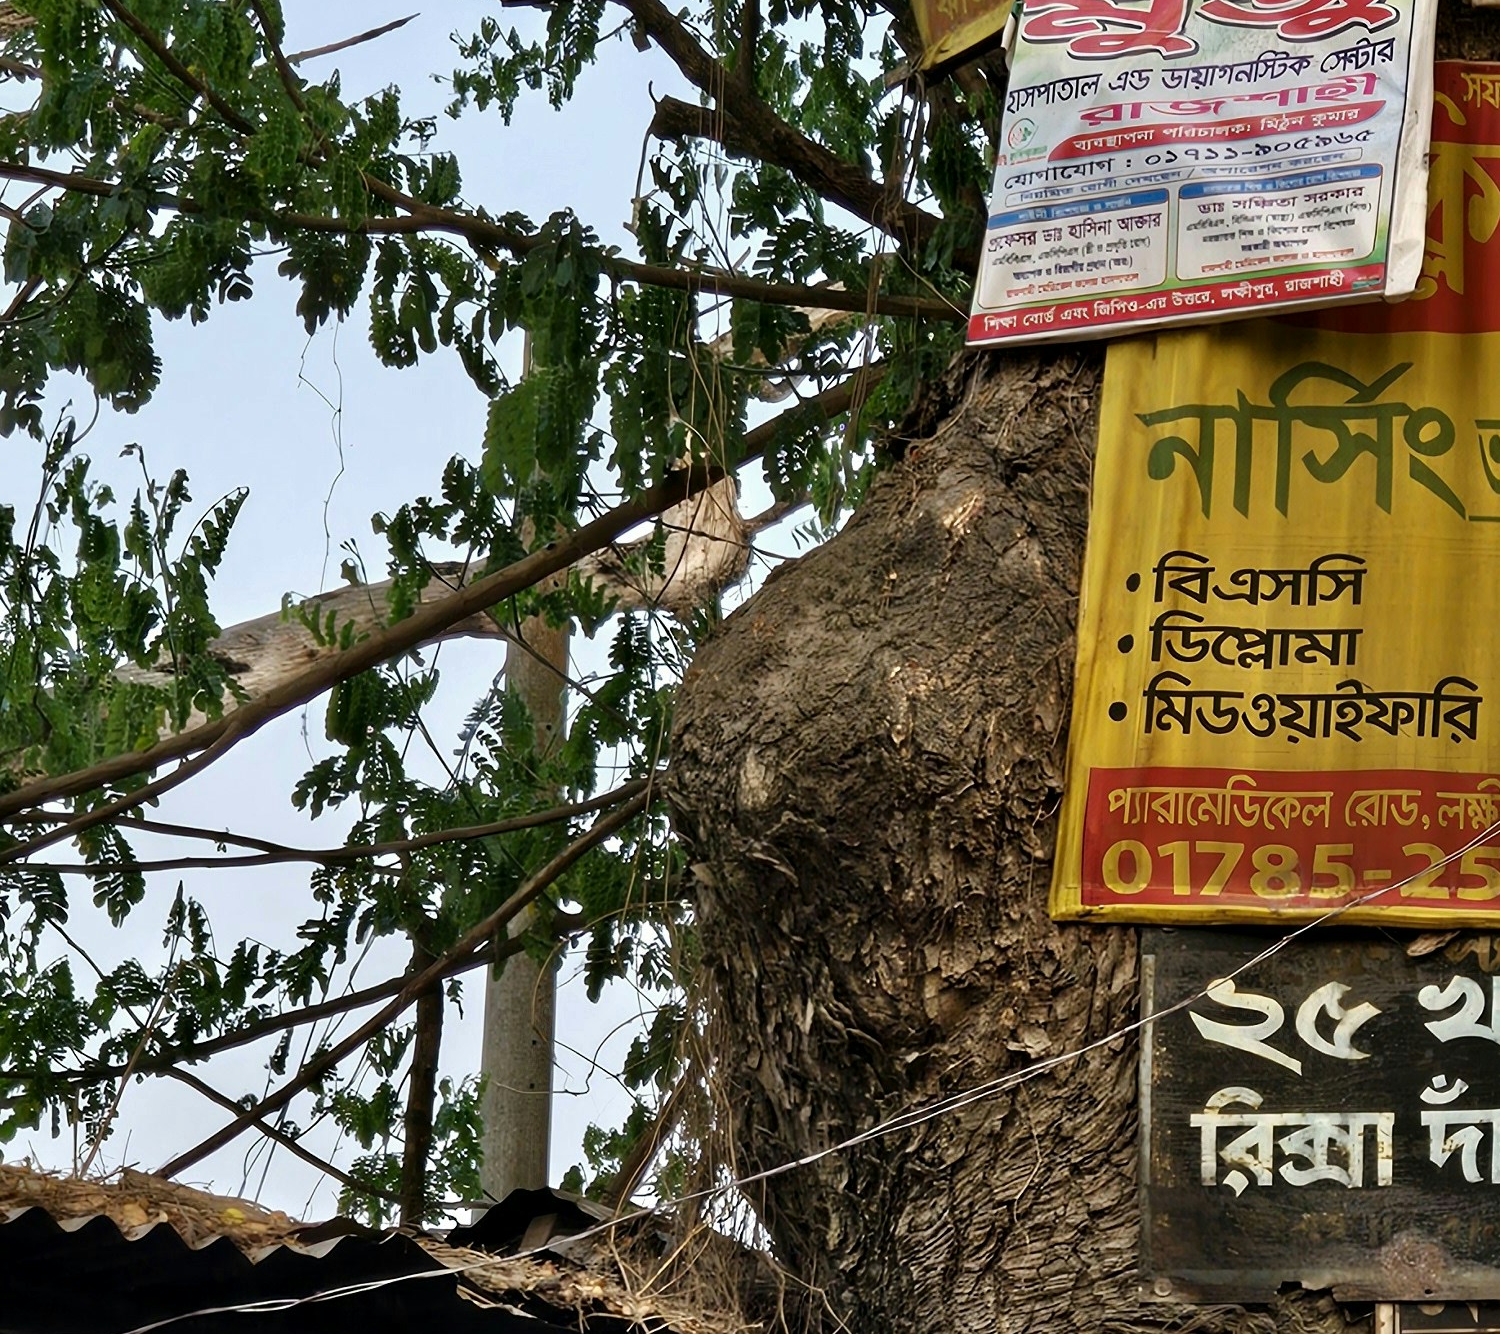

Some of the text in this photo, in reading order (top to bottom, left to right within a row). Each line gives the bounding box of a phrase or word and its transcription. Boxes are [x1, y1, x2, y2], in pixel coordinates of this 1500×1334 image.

[1006, 72, 1102, 115] হাসপাতাল
[1320, 37, 1396, 75] সেন্টার
[1079, 72, 1381, 127] রাজশাহী
[1067, 217, 1112, 240] হাসিনা
[1134, 359, 1467, 520] নার্সিং
[1152, 550, 1368, 607] বিএসসি
[1149, 610, 1364, 670] ডিপ্লোমা
[1143, 670, 1484, 745] মিডওয়াইফারি
[1189, 977, 1383, 1077] ২৫
[1189, 1085, 1396, 1199] রিক্সা
